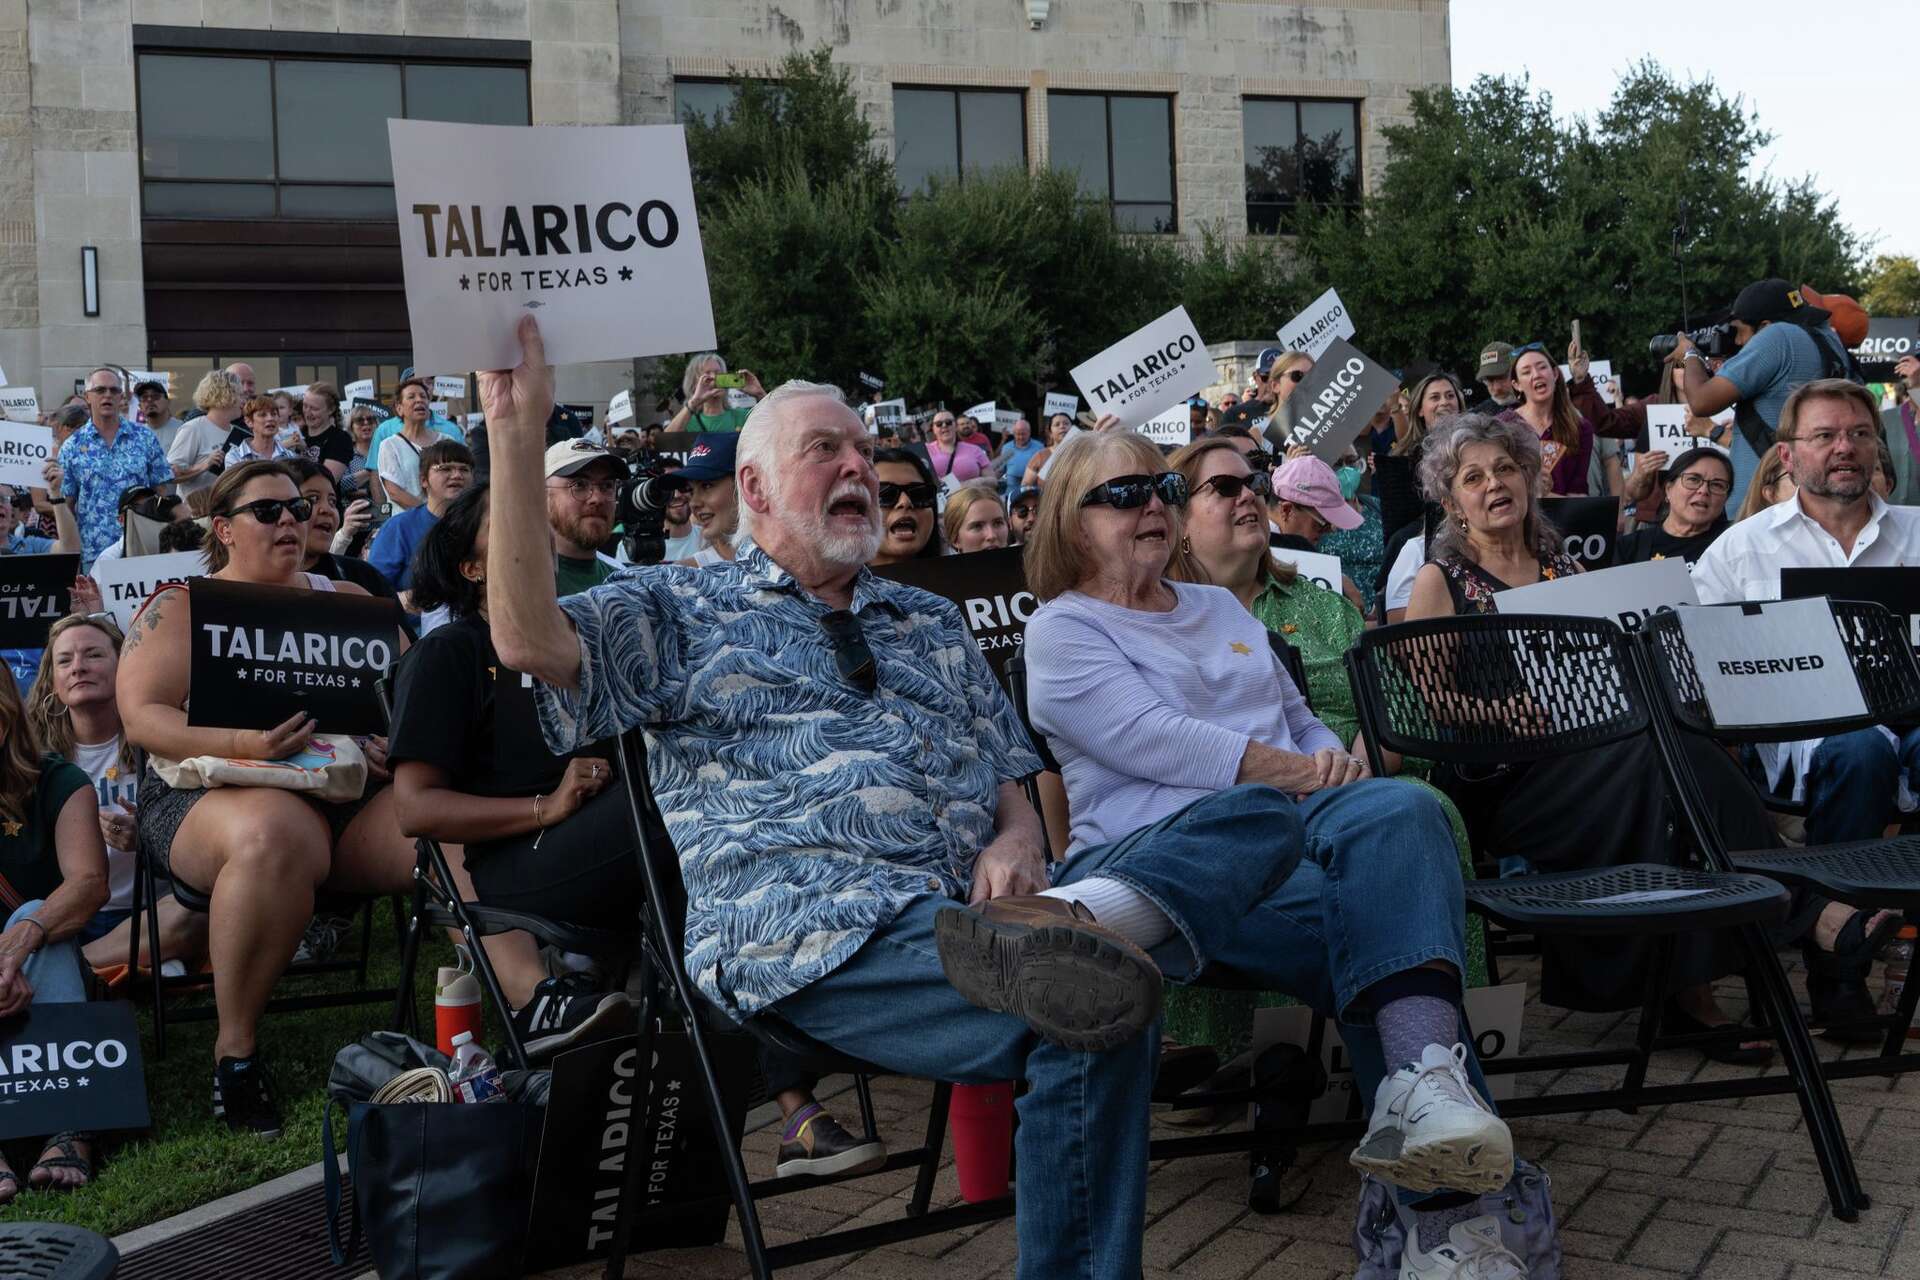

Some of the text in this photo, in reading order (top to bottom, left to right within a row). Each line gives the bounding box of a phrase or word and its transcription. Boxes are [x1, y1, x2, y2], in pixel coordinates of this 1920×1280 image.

[413, 199, 679, 258] TALARICO
[478, 266, 608, 291] FOR TEXAS
[1288, 305, 1342, 350] TALARICO
[1848, 337, 1910, 353] RICO
[1091, 334, 1195, 403] TALARICO
[1128, 367, 1178, 401] FOR TEXAS
[1284, 357, 1365, 447] TALARICO
[1318, 392, 1357, 438] FOR TEXAS
[1135, 421, 1186, 434] ARICO
[0, 440, 47, 459] RICO
[2, 584, 20, 592] FO
[203, 623, 391, 671] TALARICO
[977, 632, 1023, 650] EXAS
[254, 668, 345, 688] FOR TEXAS
[1718, 654, 1825, 676] RESERVED
[0, 1039, 127, 1076] RICO
[0, 1077, 70, 1095] TEXAS
[648, 1096, 680, 1193] FOR TEXAS
